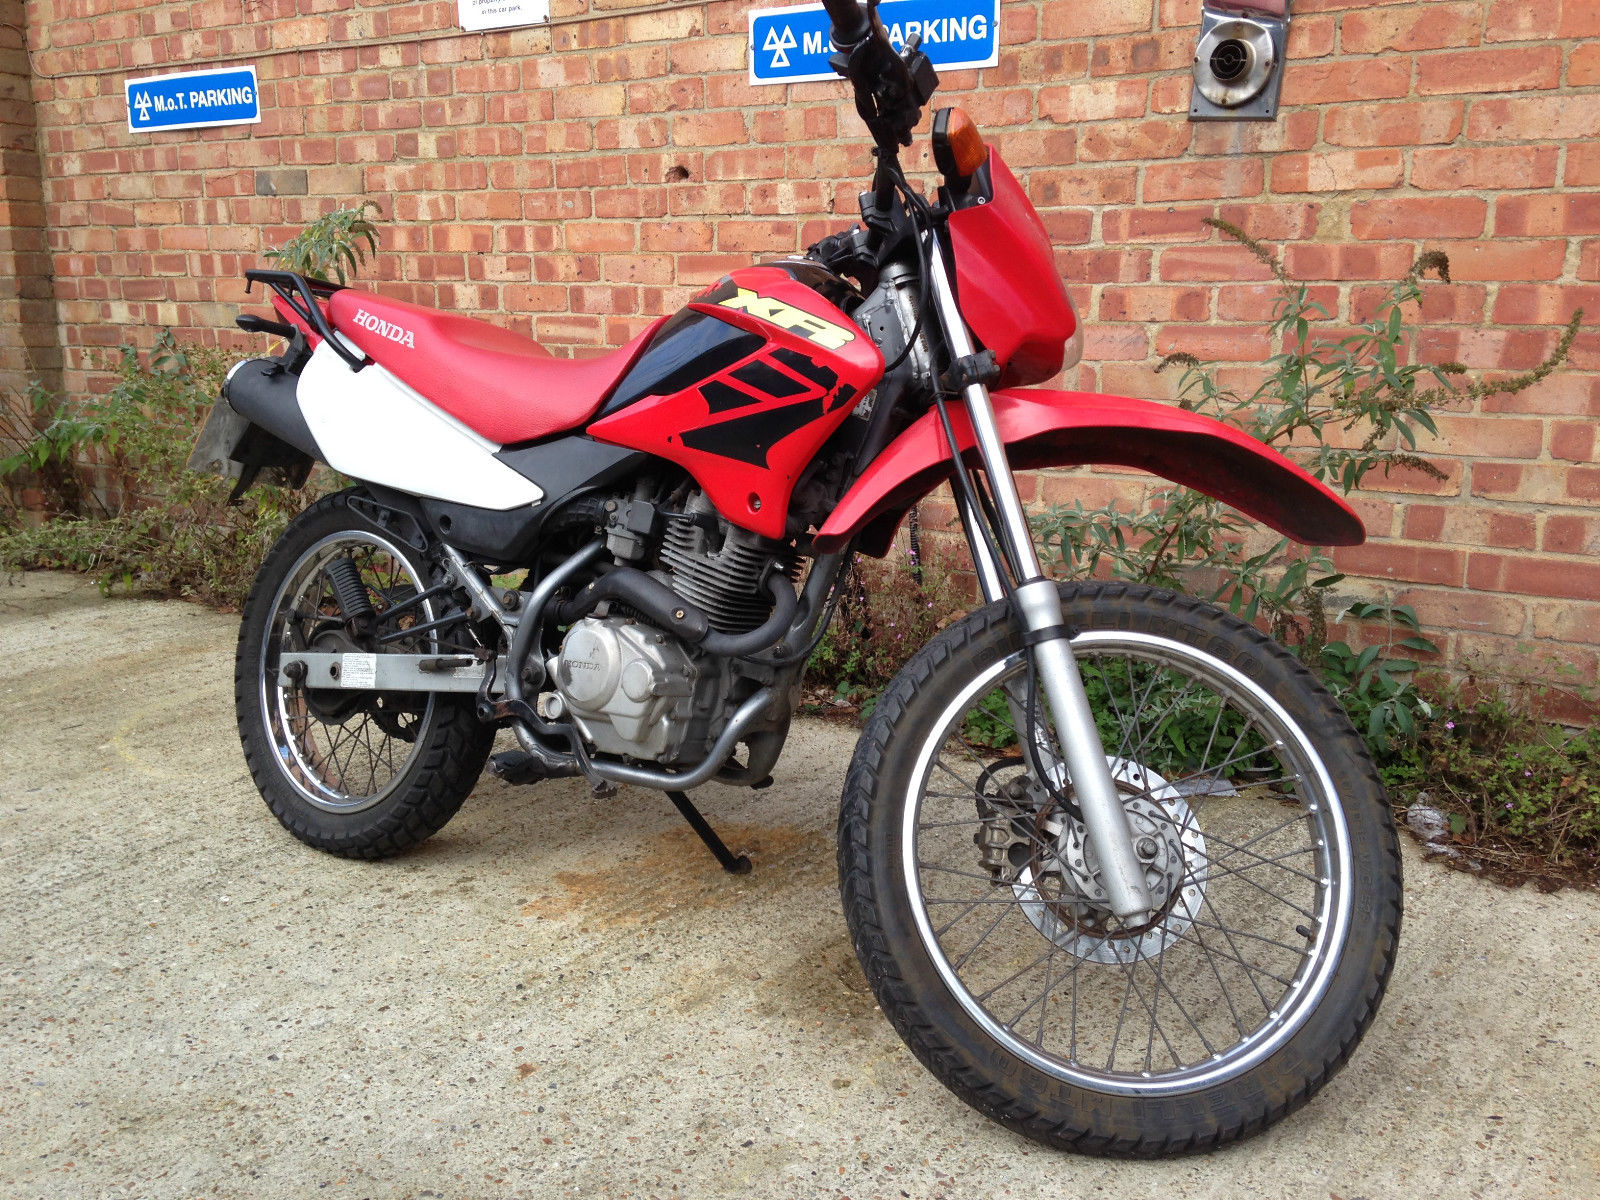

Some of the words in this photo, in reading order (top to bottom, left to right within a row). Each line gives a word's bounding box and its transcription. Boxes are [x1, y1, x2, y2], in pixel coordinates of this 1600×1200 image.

[882, 14, 987, 47] ARKING
[189, 86, 253, 109] PARKING
[352, 308, 415, 349] HONDA
[718, 287, 855, 350] XR
